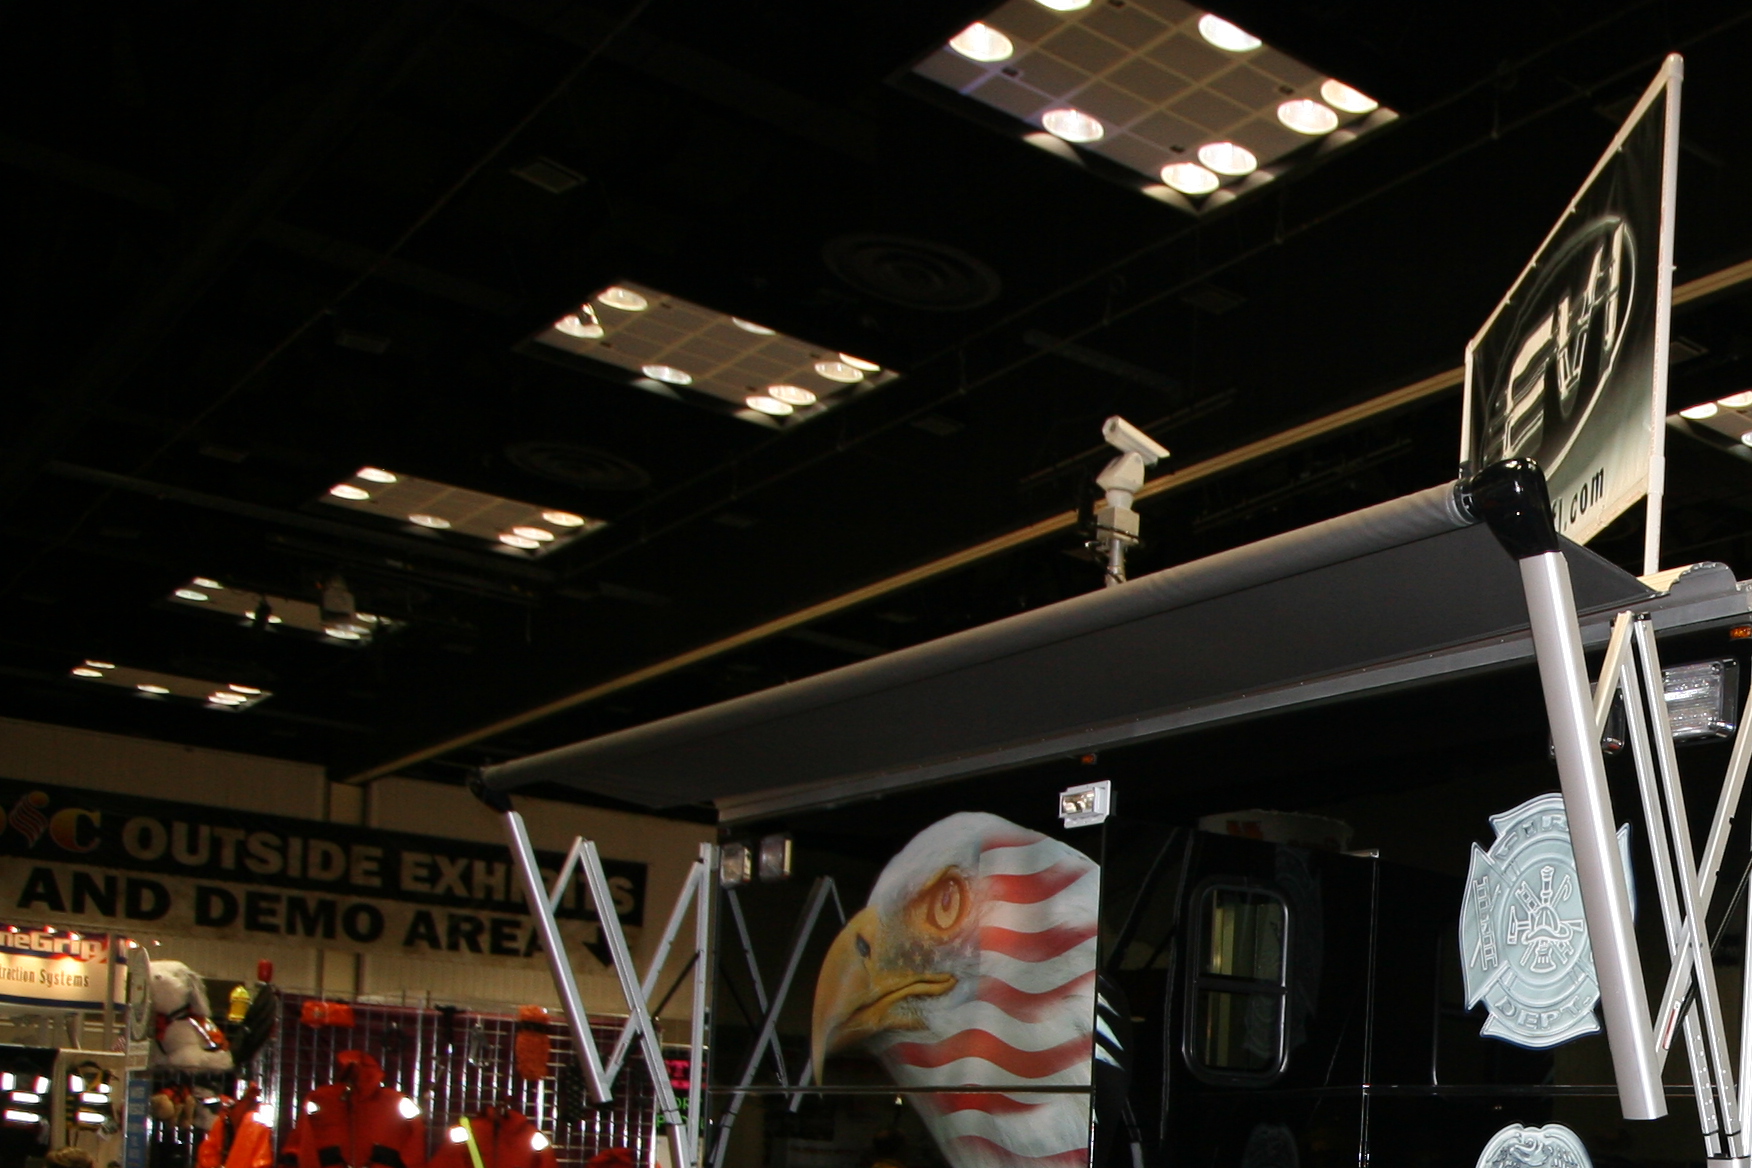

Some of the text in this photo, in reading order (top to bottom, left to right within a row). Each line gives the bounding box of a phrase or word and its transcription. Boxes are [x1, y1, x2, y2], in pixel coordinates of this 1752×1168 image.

[122, 816, 384, 888] OUTSIDE
[401, 852, 636, 916] EXHIITS
[1494, 813, 1570, 861] FIR
[17, 866, 171, 921] AND
[195, 885, 385, 944] DEMO
[39, 968, 90, 988] Systems
